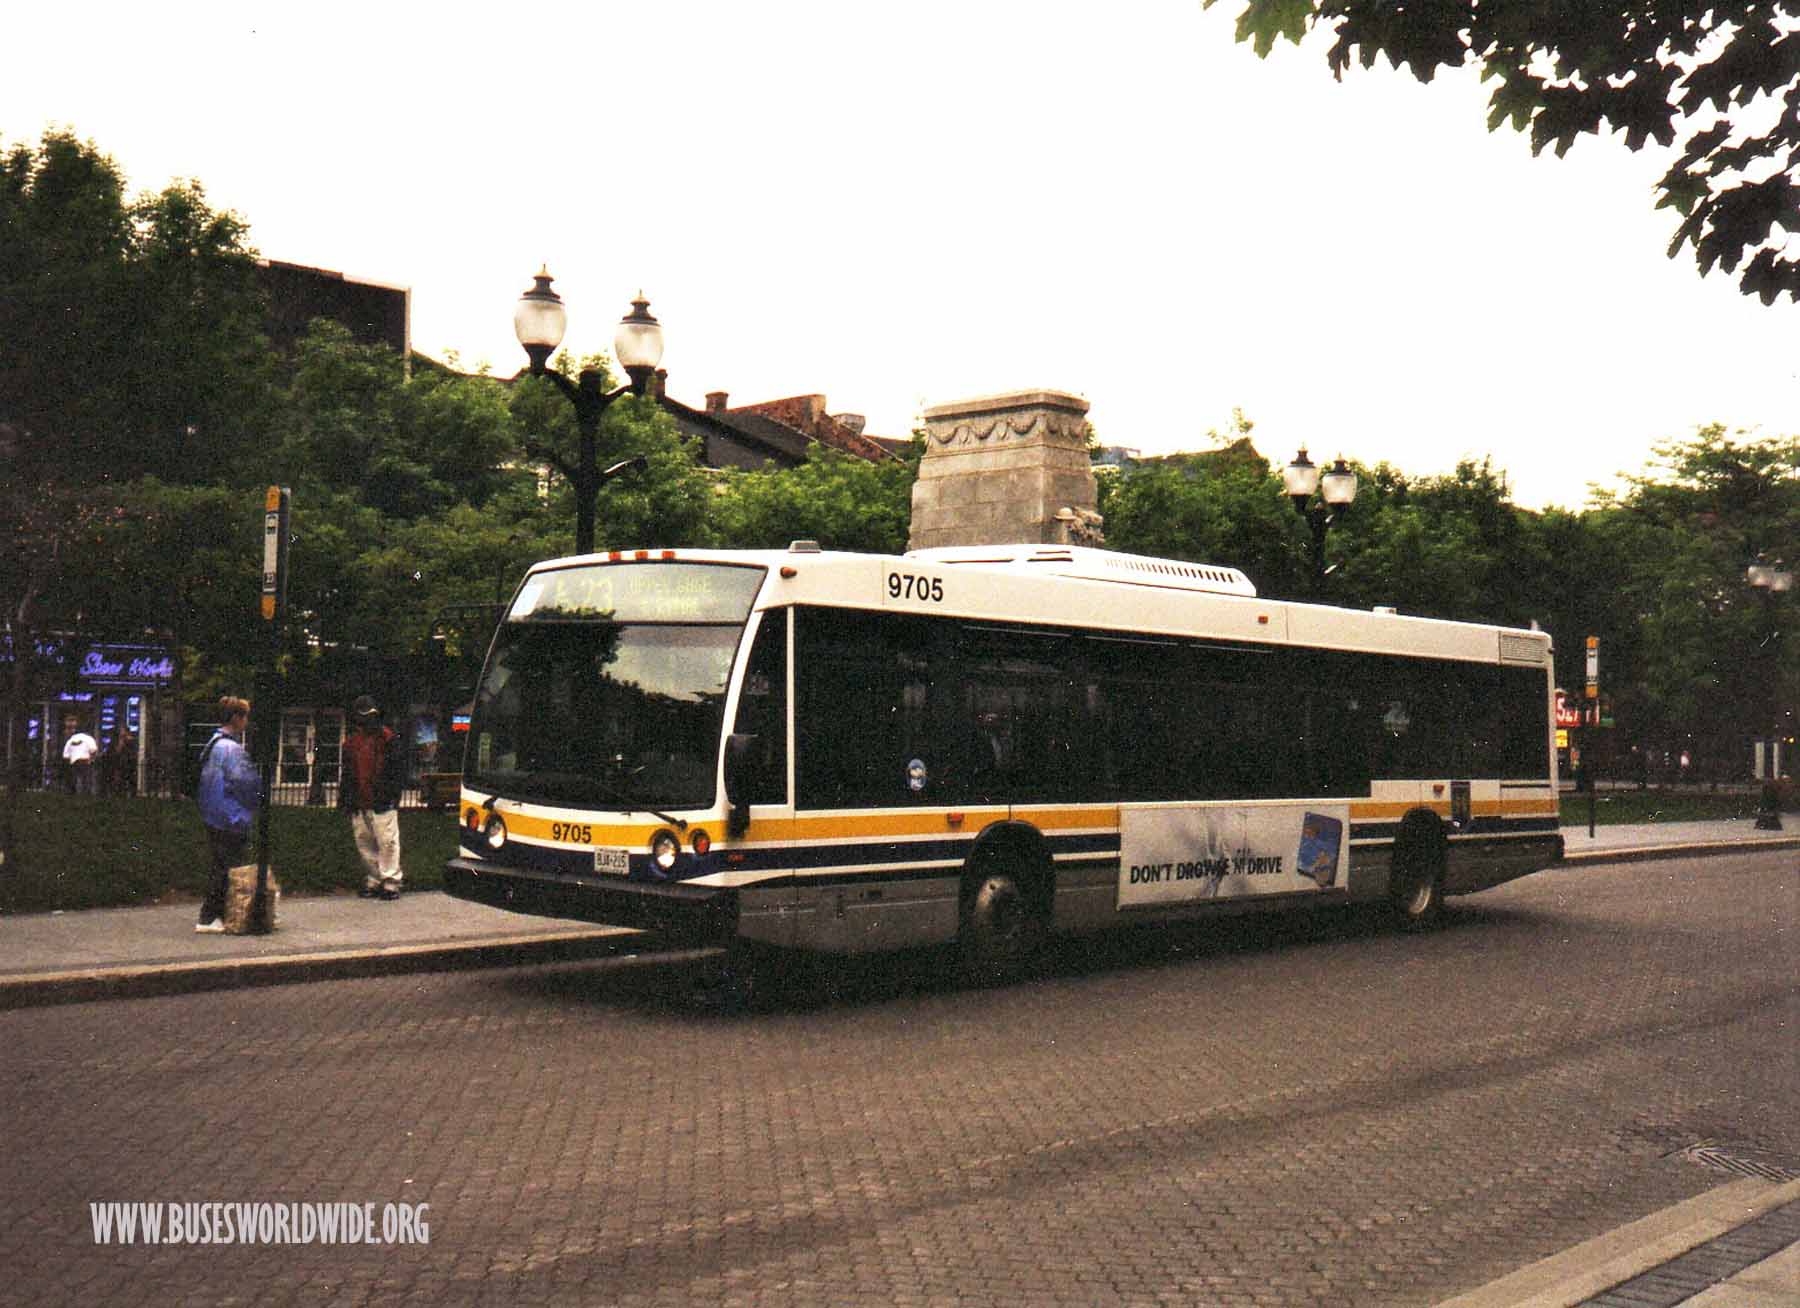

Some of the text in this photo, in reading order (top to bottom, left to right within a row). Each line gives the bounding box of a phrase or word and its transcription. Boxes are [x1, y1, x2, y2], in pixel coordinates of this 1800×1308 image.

[889, 573, 943, 602] 9705
[552, 823, 592, 844] 9705
[1130, 863, 1173, 884] DON'T
[1247, 856, 1282, 875] DRIVE
